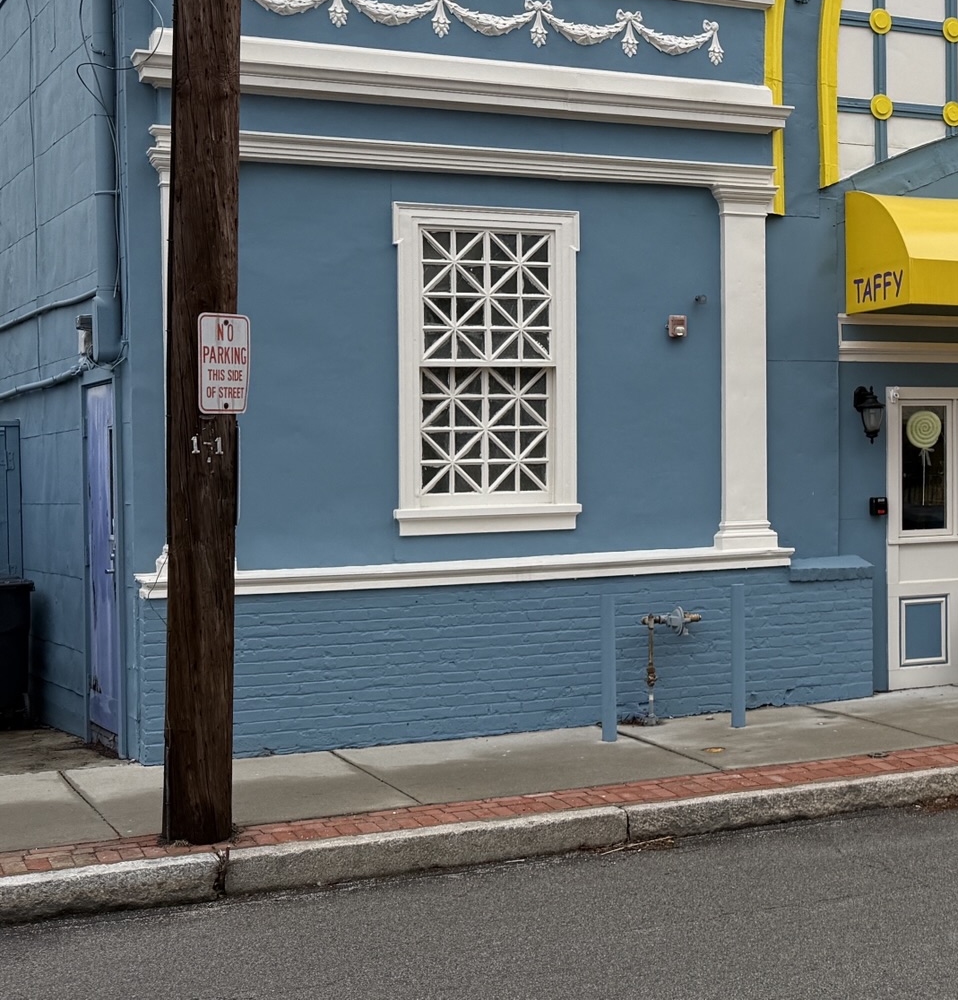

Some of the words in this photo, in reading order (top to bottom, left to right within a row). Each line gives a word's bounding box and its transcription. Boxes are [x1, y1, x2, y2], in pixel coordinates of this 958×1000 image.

[853, 269, 904, 304] TAFFY
[217, 323, 234, 342] NO
[203, 345, 247, 365] PARKING
[207, 369, 225, 382] THIS
[227, 369, 243, 382] SIDE
[206, 386, 216, 399] OF
[218, 386, 245, 399] STREET
